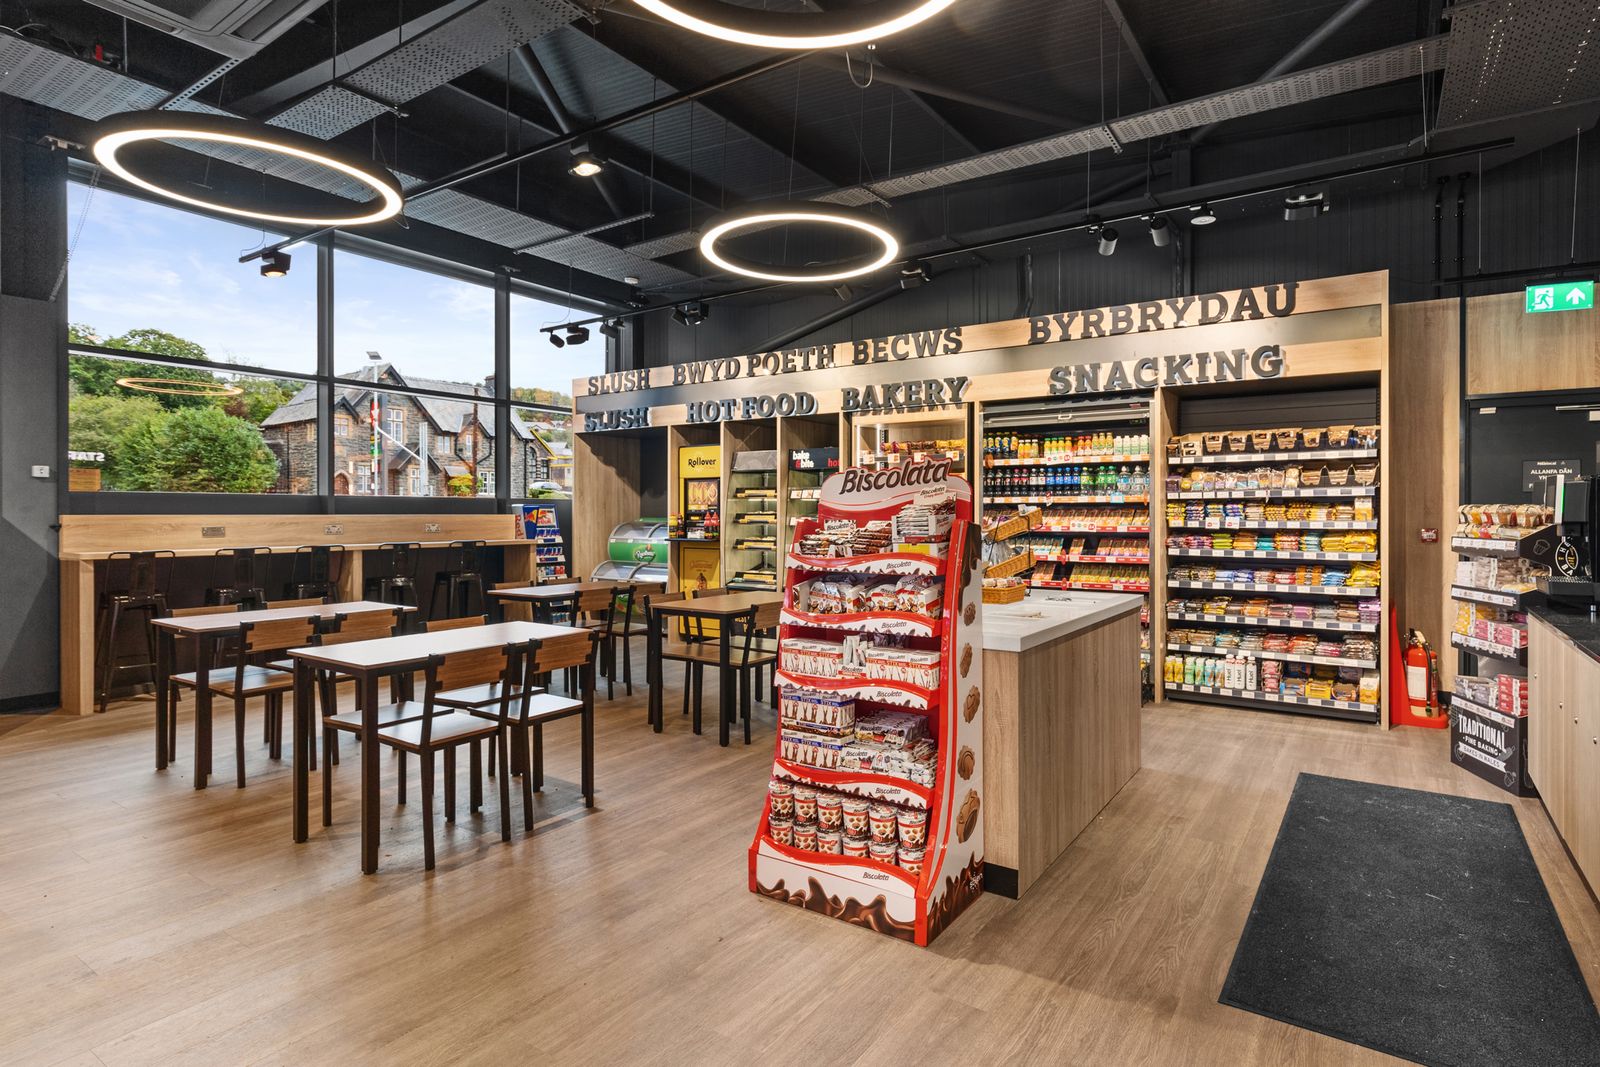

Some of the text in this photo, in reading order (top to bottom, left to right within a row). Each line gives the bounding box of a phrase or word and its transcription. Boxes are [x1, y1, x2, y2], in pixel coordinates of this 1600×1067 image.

[1028, 283, 1299, 345] BYRBRYDAU
[852, 326, 964, 365] BECWS
[673, 343, 836, 386] BWYD POETH
[1049, 344, 1284, 395] SNACKING
[588, 369, 651, 396] SLUSH
[841, 376, 969, 410] BAKERY
[585, 407, 650, 432] SLUSH
[686, 391, 817, 423] HOT FOOD
[688, 458, 717, 468] Rollover
[792, 450, 810, 460] bake
[840, 458, 951, 495] Biscolata
[886, 561, 912, 569] Biscolata
[881, 621, 907, 629] Biscolata
[1458, 714, 1507, 754] TRADITIONAL
[1477, 741, 1499, 756] BAKING
[875, 787, 901, 795] Biscolata
[862, 871, 890, 881] Biscolata
